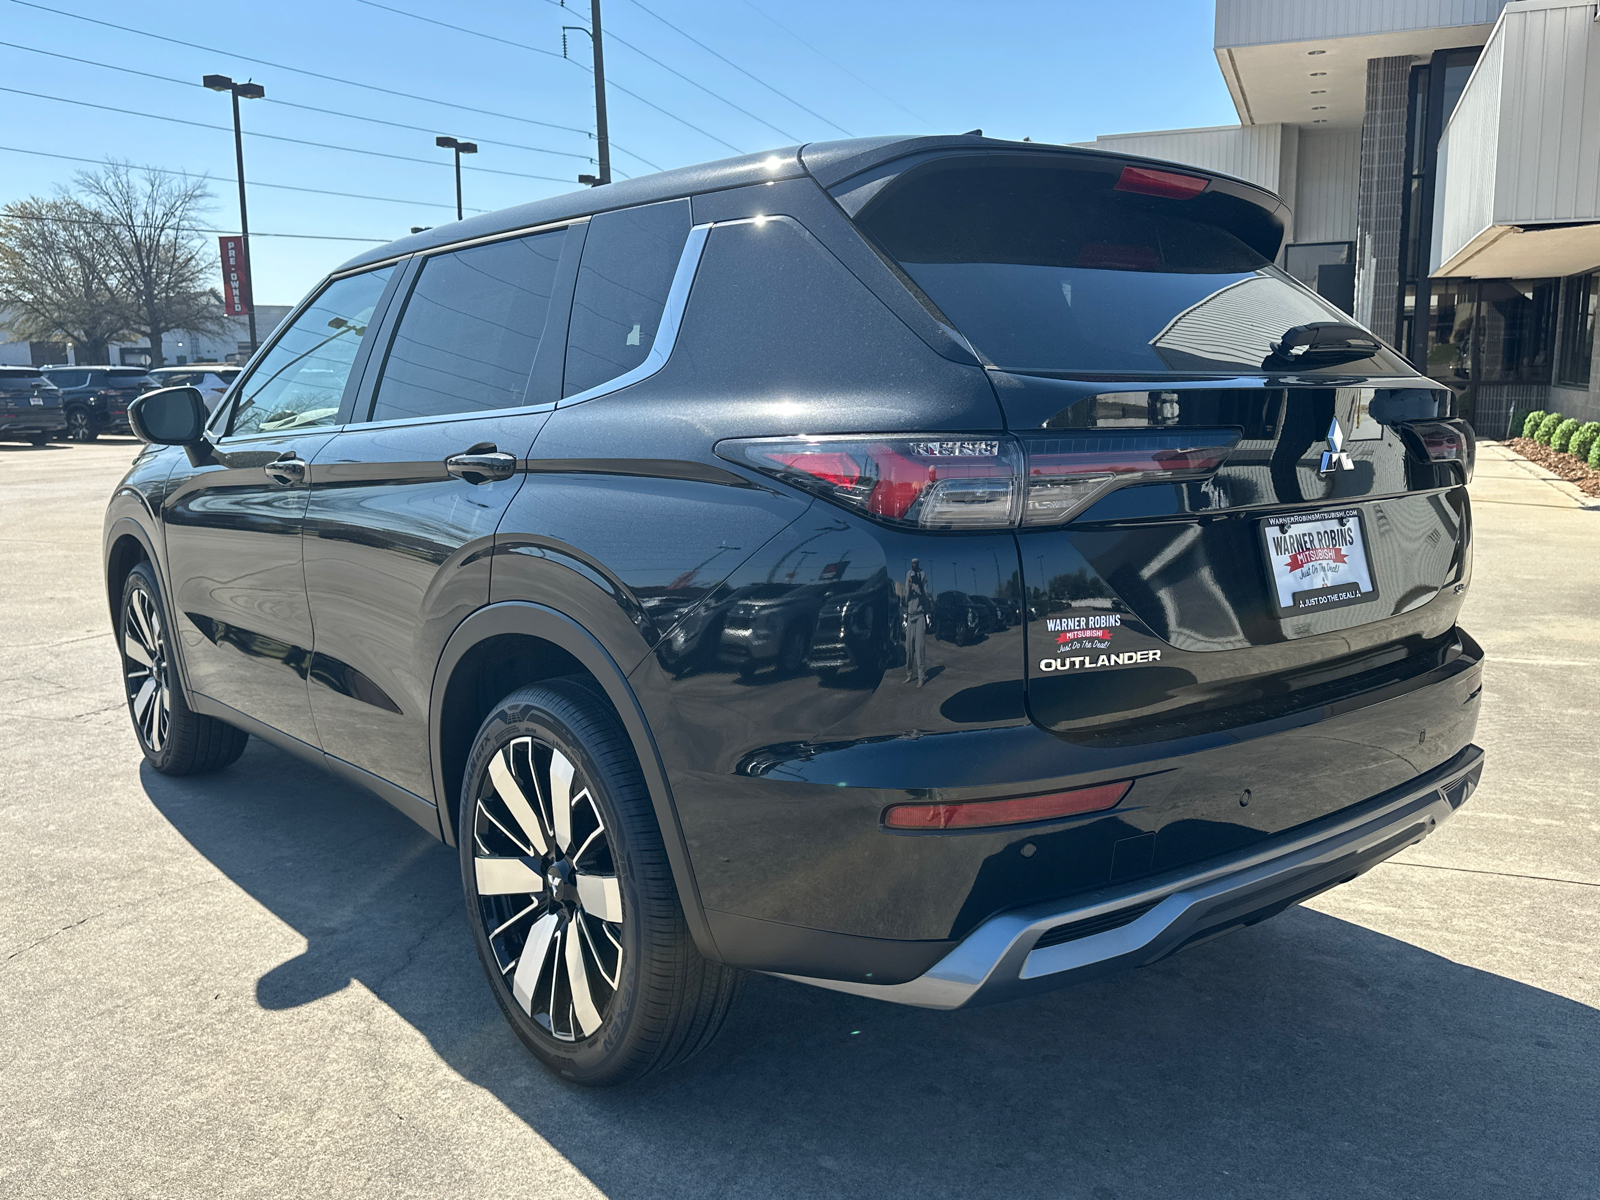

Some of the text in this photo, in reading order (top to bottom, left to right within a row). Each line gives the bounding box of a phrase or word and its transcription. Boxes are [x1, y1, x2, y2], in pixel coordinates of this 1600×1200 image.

[228, 242, 241, 311] PRE-OWNED
[1273, 527, 1354, 556] WARNER ROBINS
[1297, 548, 1336, 564] MITSUBISHI
[1299, 567, 1311, 580] Just
[1311, 564, 1318, 575] Do
[1305, 590, 1355, 607] JUST DO THE DEAL!
[1046, 614, 1121, 632] WARNER ROBINS
[1066, 629, 1103, 640] MITSUBISHI
[1057, 639, 1111, 654] Just Do The Deal!
[1039, 649, 1162, 672] OUTLANDER
[602, 964, 635, 1054] NEXEN
